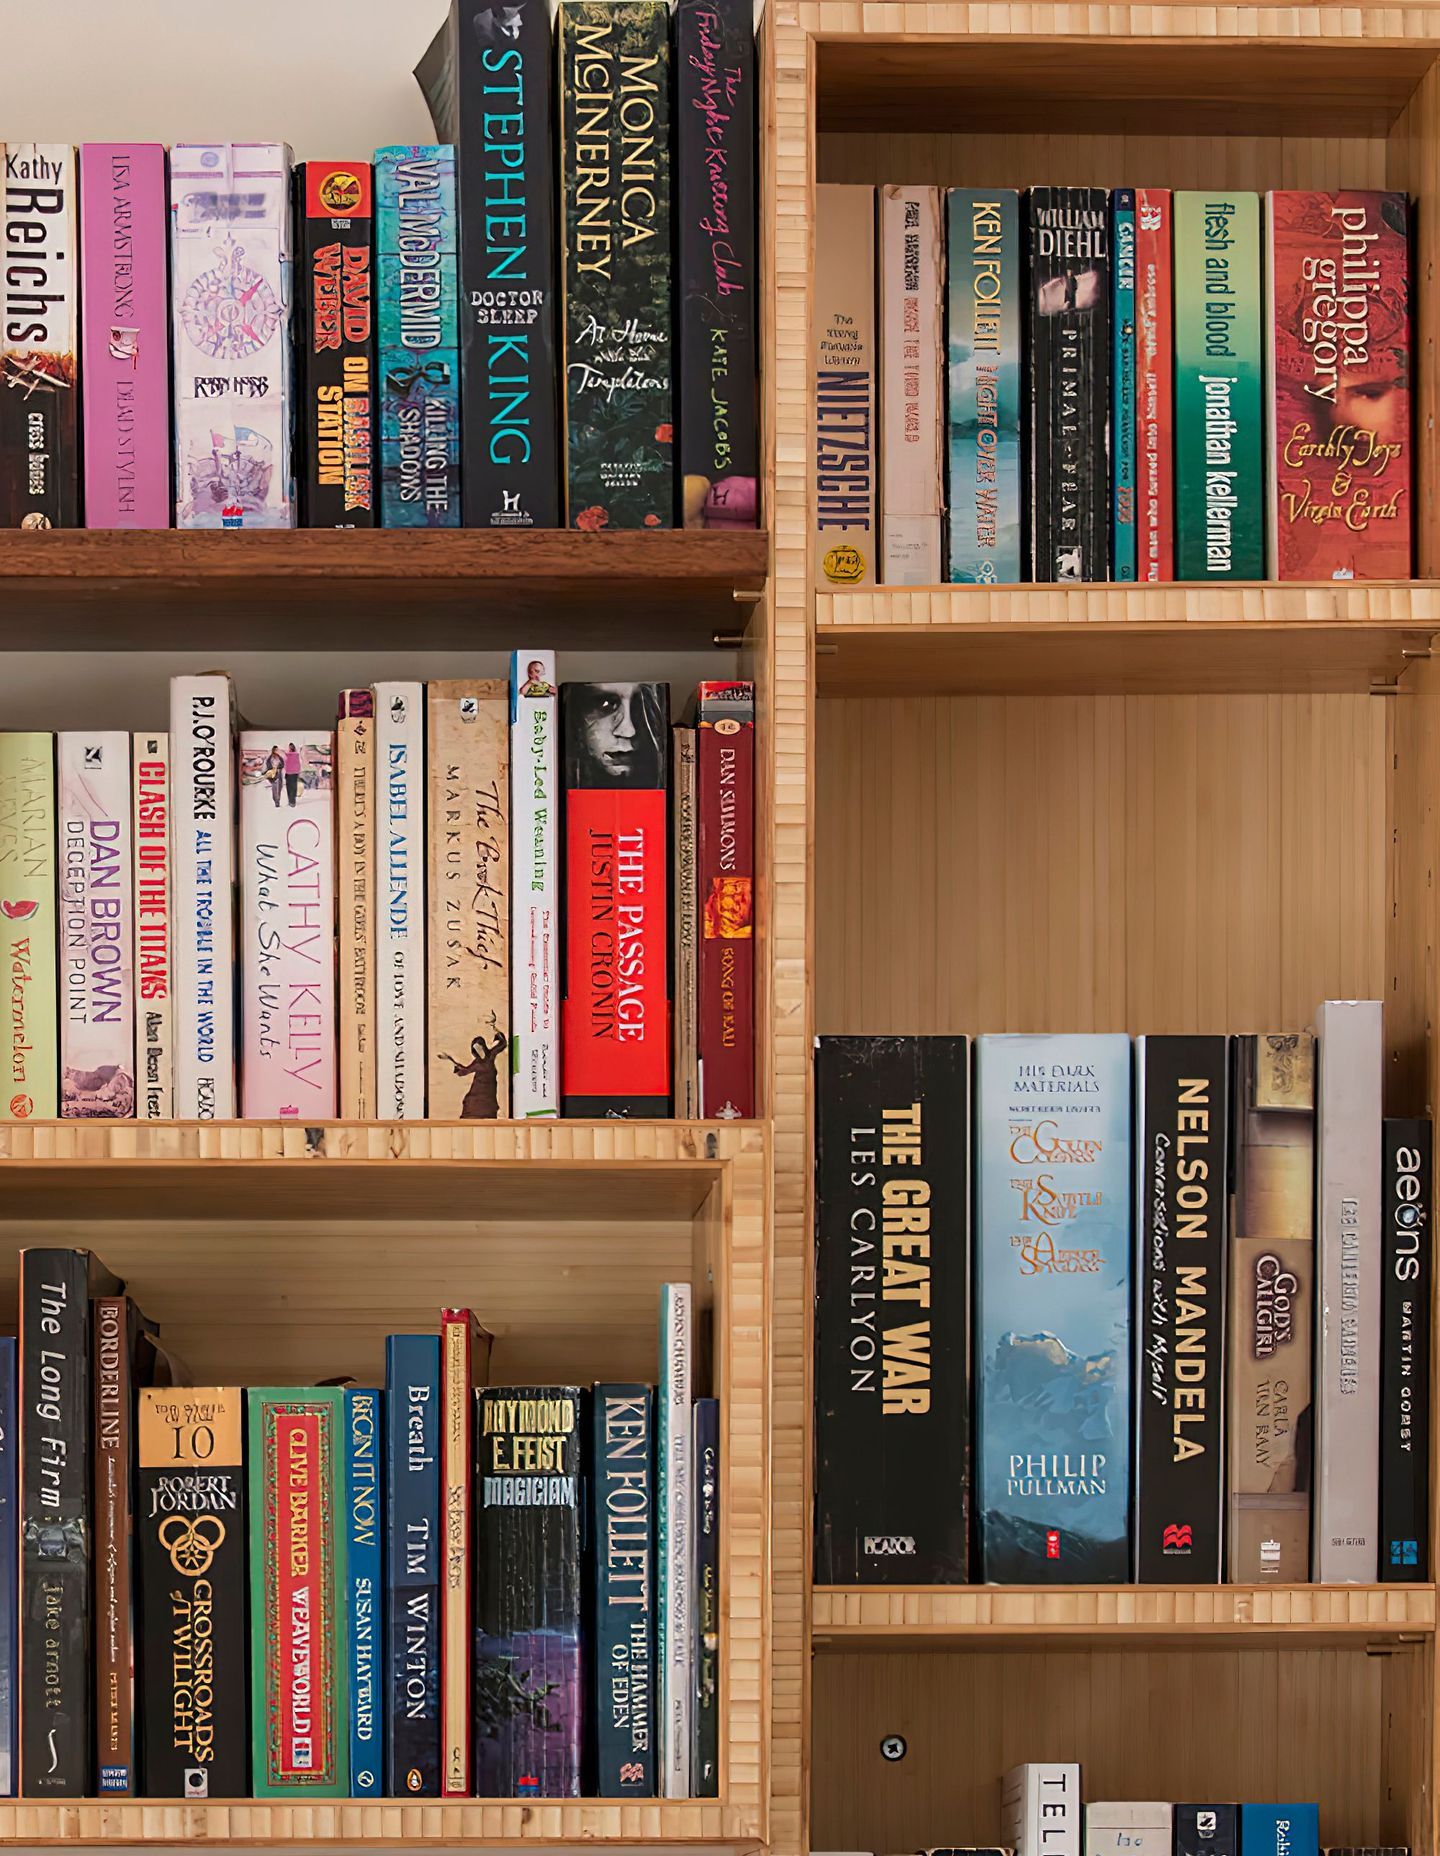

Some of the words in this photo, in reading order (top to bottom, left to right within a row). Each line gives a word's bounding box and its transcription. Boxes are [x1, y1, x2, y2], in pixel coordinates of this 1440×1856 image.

[722, 67, 742, 107] The
[5, 153, 63, 185] Kathy
[482, 50, 527, 279] STEPHEN
[617, 54, 658, 248] MONICA
[5, 187, 65, 343] Reichs
[1039, 229, 1105, 257] DIEHL
[1205, 203, 1235, 251] flesh
[343, 246, 370, 343] DAVID
[471, 290, 543, 306] DOCTOR
[1205, 258, 1235, 294] and
[1331, 207, 1381, 365] philippa
[710, 330, 729, 381] KATE
[1206, 302, 1236, 357] blood
[1302, 257, 1339, 404] gregory
[487, 335, 531, 464] KING
[1061, 330, 1076, 436] PRIMAL
[1199, 376, 1237, 464] jonathan
[318, 386, 343, 485] STATION
[399, 407, 422, 501] SHADOWS
[425, 397, 446, 470] KILLING
[710, 388, 731, 470] JACOBS
[818, 372, 869, 531] NIETZSCHE
[426, 476, 448, 511] THE
[1061, 463, 1076, 531] FEAR
[1206, 471, 1236, 572] kellerman
[389, 743, 407, 824] ISABEL
[532, 711, 547, 799] Baby-Led
[139, 762, 166, 838] CLASH
[446, 765, 461, 879] MARKUS
[89, 821, 120, 887] DAN
[140, 851, 166, 875] OF
[196, 830, 212, 854] ALL
[197, 860, 212, 884] THE
[256, 843, 280, 911] What
[531, 808, 548, 892] Weaning
[590, 830, 613, 922] JUSTIN
[618, 828, 644, 894] THE
[66, 821, 84, 947] DECEPTION
[140, 877, 166, 917] THE
[285, 819, 322, 963] CATHY
[390, 830, 408, 938] ALLENDE
[91, 900, 122, 1023] BROWN
[139, 925, 167, 999] TITANS
[197, 959, 213, 973] IN
[258, 922, 281, 976] She
[446, 901, 462, 990] ZUSAK
[592, 932, 614, 1039] CRONIN
[618, 905, 645, 1042] PASSAGE
[68, 959, 87, 1024] POINT
[198, 981, 213, 1004] THE
[257, 984, 280, 1058] Wants
[198, 1011, 214, 1063] WORLD
[284, 984, 322, 1090] KELLY
[850, 1127, 875, 1186] LES
[882, 1103, 921, 1165] THE
[1177, 1078, 1209, 1238] NELSON
[882, 1179, 930, 1308] GREAT
[40, 1282, 66, 1334] The
[850, 1208, 876, 1392] CARLYON
[37, 1351, 66, 1420] Long
[99, 1304, 120, 1449] BORDERLINE
[882, 1320, 931, 1415] WAR
[1173, 1267, 1206, 1463] MANDELA
[290, 1428, 307, 1486] CLIVE
[407, 1385, 433, 1472] Breath
[605, 1396, 647, 1459] KEN
[1010, 1453, 1107, 1478] PHILIP
[41, 1436, 66, 1507] Firm
[158, 1476, 232, 1488] ROBERT
[1008, 1478, 1106, 1497] PULLMAN
[290, 1492, 309, 1577] BARKER
[406, 1518, 429, 1575] TIM
[607, 1470, 648, 1611] FOLLETT
[355, 1577, 371, 1641] SUSAN
[630, 1619, 647, 1658] THE
[173, 1603, 193, 1754] TWILIGHT
[192, 1579, 214, 1762] CROSSROADS
[292, 1586, 310, 1734] WEAVEWORLD
[356, 1645, 372, 1741] HAYWARD
[405, 1593, 429, 1719] WINTON
[612, 1644, 629, 1671] OF
[612, 1677, 630, 1729] EDEN
[630, 1664, 649, 1752] HAMMER
